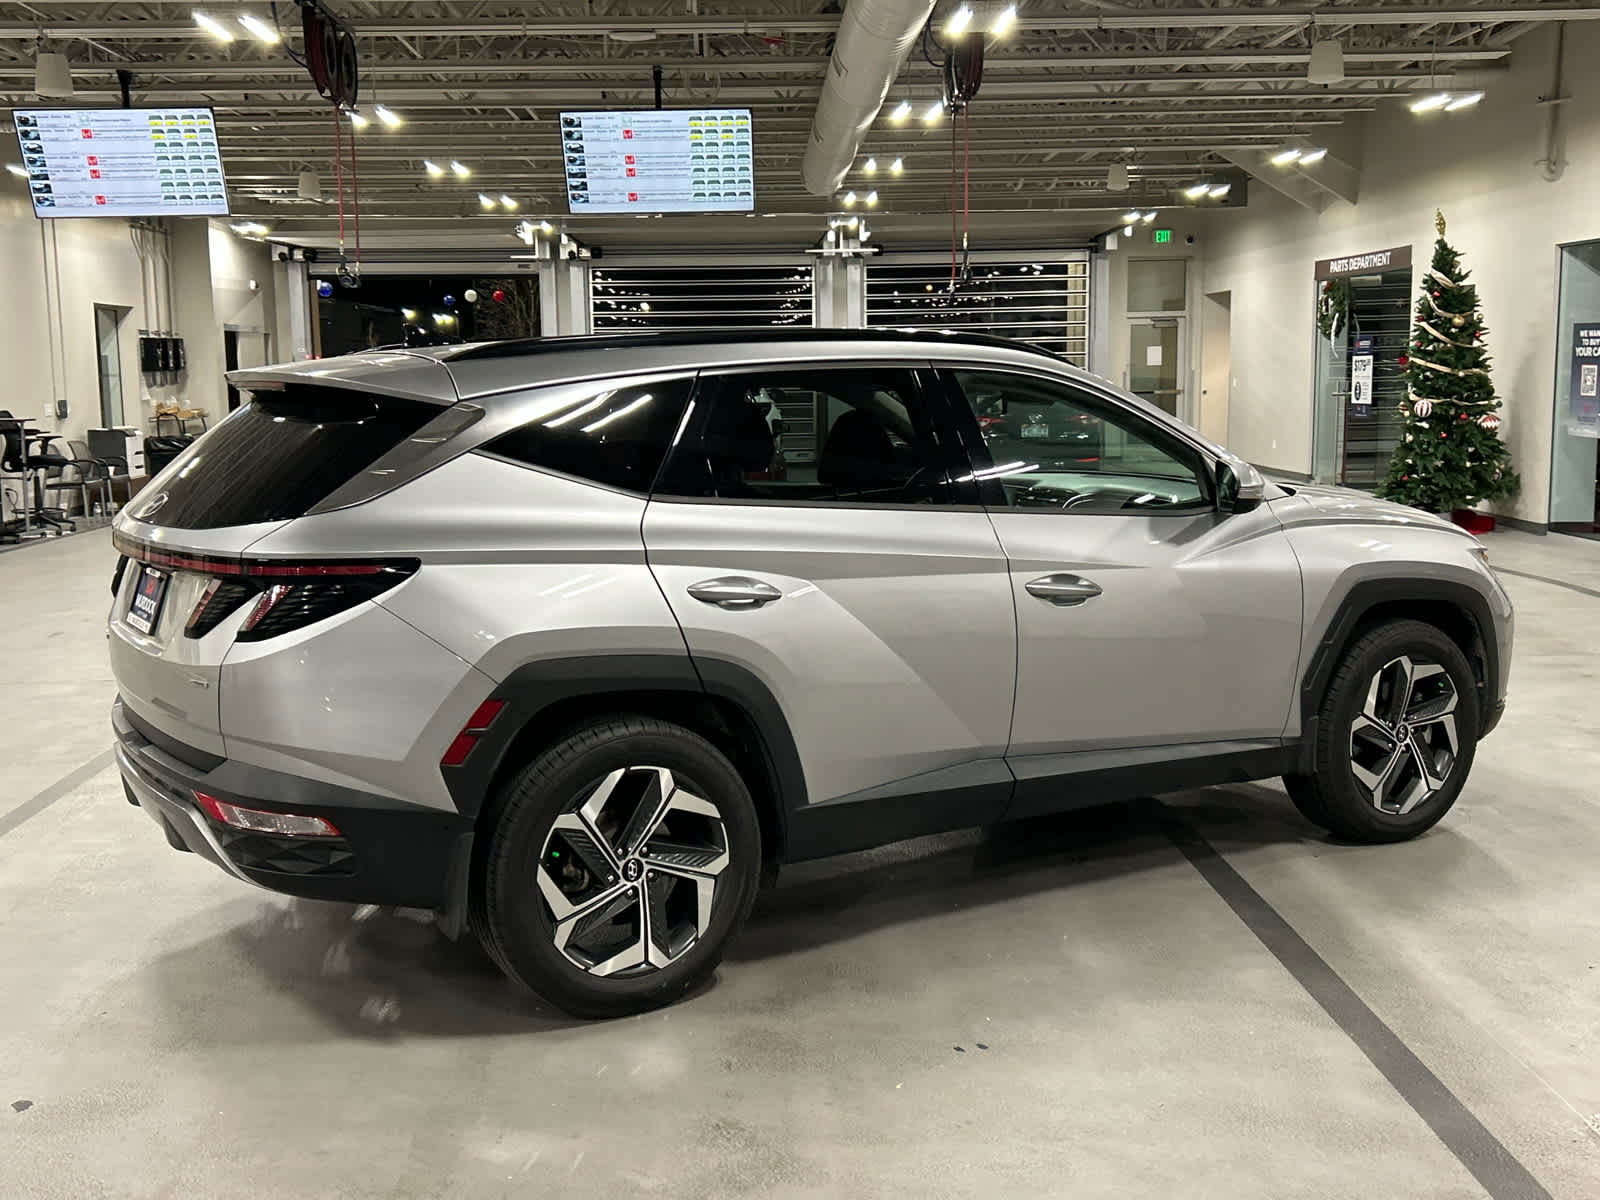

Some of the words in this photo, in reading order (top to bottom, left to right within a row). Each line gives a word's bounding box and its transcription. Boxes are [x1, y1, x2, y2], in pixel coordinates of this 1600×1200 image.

[1156, 230, 1172, 243] EXIT
[1330, 260, 1348, 273] PARTS
[1349, 252, 1391, 271] DEPARTMENT
[1576, 346, 1592, 356] YOUR
